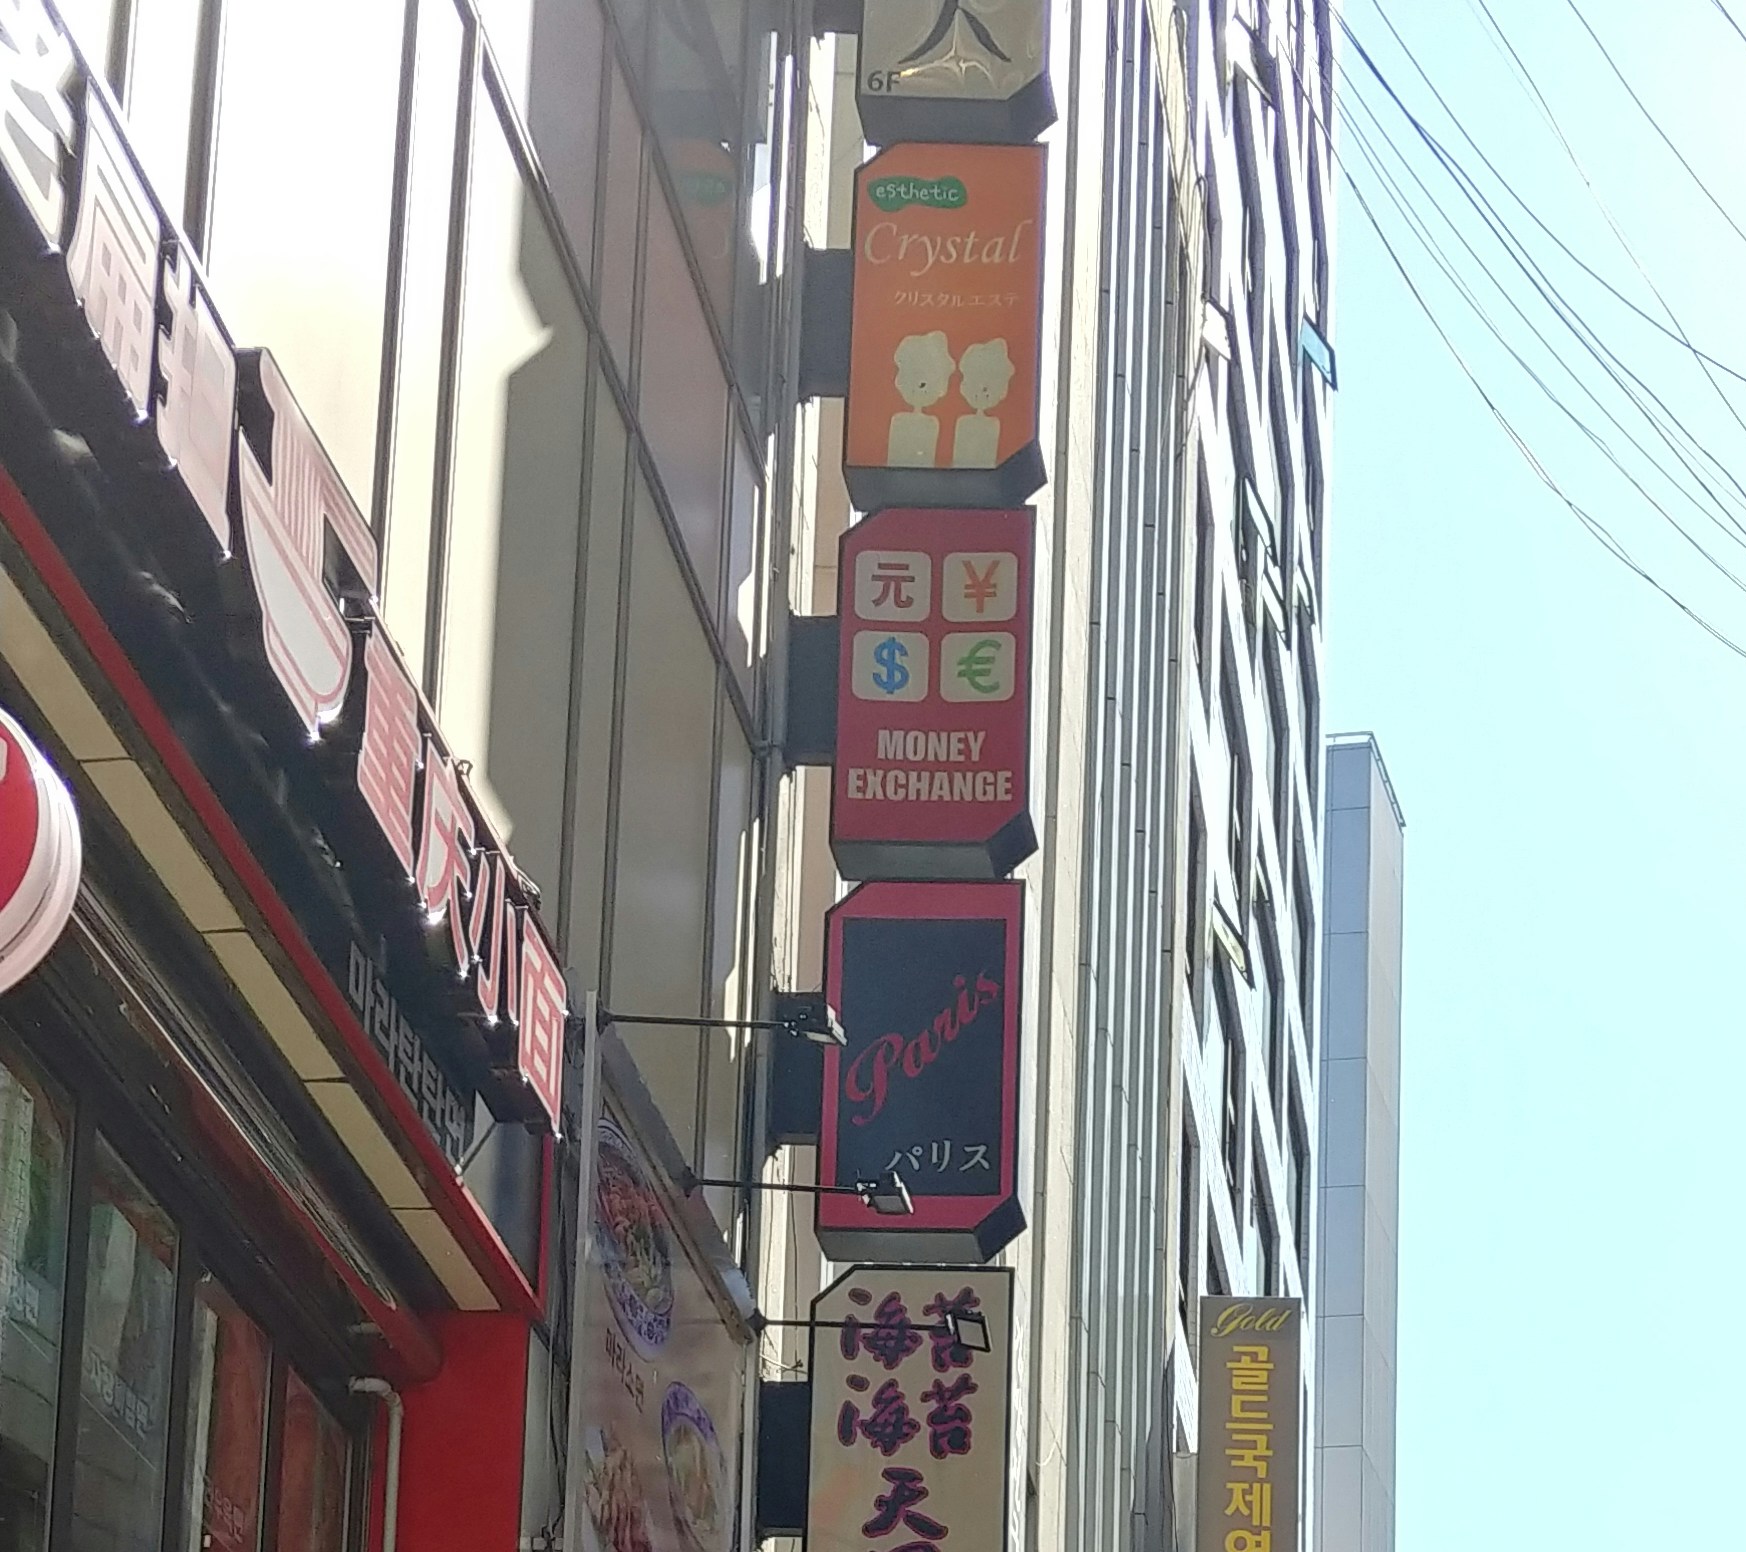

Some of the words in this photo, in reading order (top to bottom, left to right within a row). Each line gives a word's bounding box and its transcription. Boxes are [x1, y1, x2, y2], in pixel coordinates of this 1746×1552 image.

[874, 181, 960, 204] esthetic
[863, 219, 1034, 276] Crystal
[877, 728, 987, 764] MONEY
[847, 768, 1013, 802] EXCHANGE
[845, 966, 1003, 1126] Paris
[884, 1142, 992, 1174] パリス
[1210, 1302, 1292, 1338] Gold
